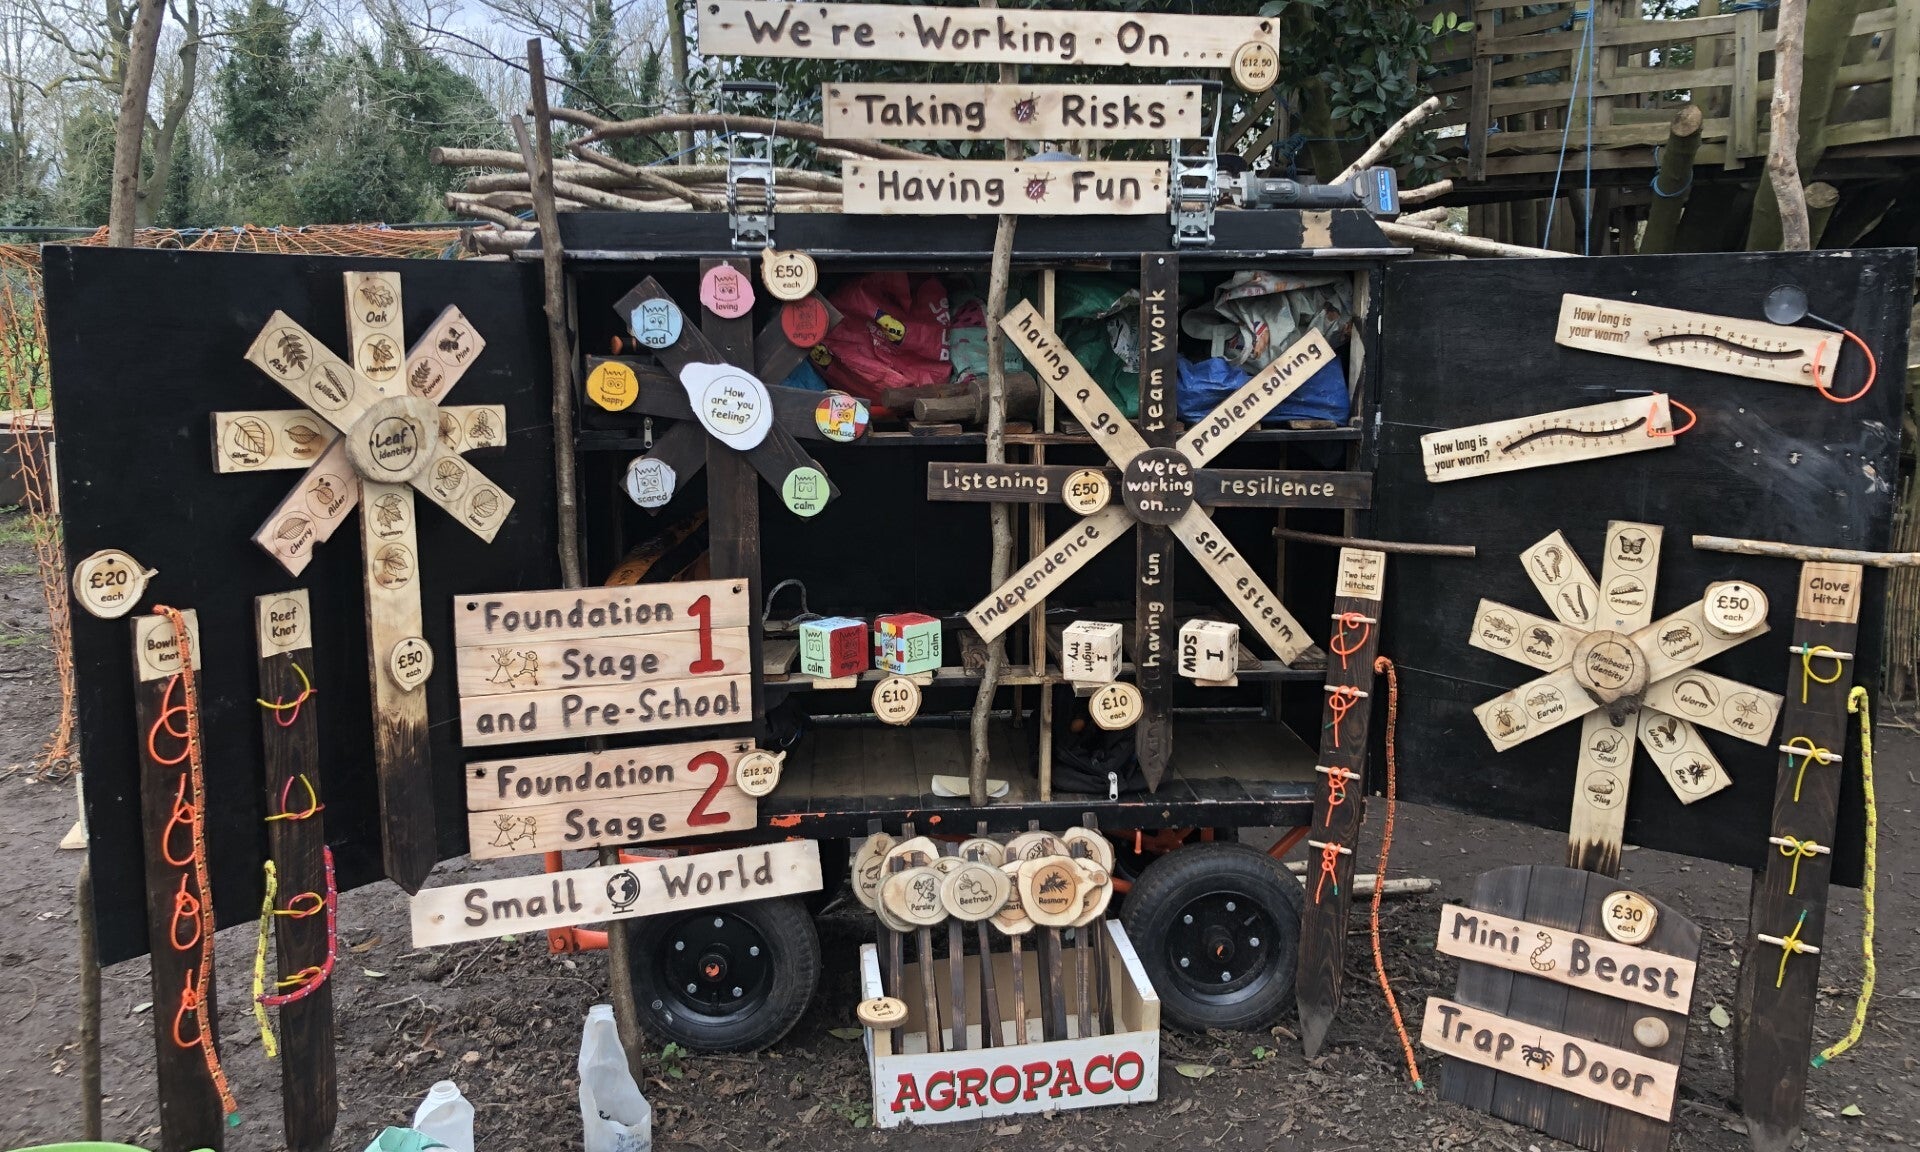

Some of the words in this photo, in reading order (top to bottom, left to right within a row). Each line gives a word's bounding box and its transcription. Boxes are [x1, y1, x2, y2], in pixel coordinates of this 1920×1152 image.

[745, 9, 876, 49] We're
[913, 13, 1079, 58] Working
[1242, 58, 1272, 67] £12.50
[1249, 70, 1265, 78] each
[856, 94, 986, 133] Taking
[1061, 93, 1167, 127] Risks
[878, 170, 1006, 206] Having
[1072, 170, 1141, 202] Fun
[774, 265, 803, 278] £50
[715, 302, 738, 312] loving
[366, 310, 387, 323] Oak
[1573, 307, 1596, 321] How
[1598, 309, 1620, 328] long
[1622, 313, 1633, 327] is
[645, 333, 667, 345] sad
[792, 332, 817, 341] angry
[1568, 325, 1598, 339] your
[1599, 327, 1631, 344] worm?
[455, 346, 470, 363] Pine
[268, 357, 288, 375] Ash
[1017, 312, 1071, 382] having
[1076, 388, 1091, 404] a
[1090, 411, 1119, 437] go
[314, 381, 342, 404] Willow
[422, 374, 443, 397] Rowan
[723, 386, 745, 398] How
[600, 394, 625, 407] happy
[711, 397, 728, 406] are
[736, 400, 755, 413] you
[1146, 367, 1166, 432] team
[1191, 390, 1261, 457] problem
[1262, 341, 1323, 397] solving
[711, 408, 751, 425] feeling?
[375, 430, 409, 450] Leaf
[822, 427, 857, 438] confused
[379, 446, 413, 460] identity
[1433, 441, 1454, 455] How
[1455, 437, 1477, 453] long
[1478, 435, 1489, 447] is
[1434, 456, 1456, 473] your
[1457, 449, 1491, 467] worm?
[1072, 482, 1099, 497] £50
[1126, 477, 1193, 497] working
[1220, 477, 1336, 498] resilience
[328, 494, 346, 517] Alder
[636, 492, 668, 503] scared
[793, 500, 816, 511] calm
[289, 527, 314, 555] Cherry
[1617, 555, 1644, 564] Butterfly
[974, 522, 1101, 627] independence
[1142, 552, 1161, 586] fun
[1344, 570, 1358, 579] Two
[1361, 573, 1376, 581] Half
[88, 569, 128, 590] £20
[1194, 529, 1235, 567] self
[1235, 573, 1295, 644] esteem
[1344, 581, 1375, 590] Hitches
[1810, 577, 1850, 592] Clove
[100, 591, 125, 603] each
[1610, 596, 1644, 606] Caterpillar
[1716, 595, 1749, 610] £50
[1812, 592, 1845, 605] Hitch
[270, 608, 297, 622] Reef
[1723, 613, 1744, 622] each
[272, 624, 298, 638] Knot
[484, 597, 674, 633] Foundation
[687, 594, 725, 674] 1
[1142, 600, 1165, 668] having
[1482, 629, 1511, 645] Earwig
[147, 636, 191, 650] Bowli
[930, 632, 940, 657] calm
[159, 651, 180, 662] Knot
[398, 650, 423, 669] £50
[1081, 641, 1095, 673] might
[1096, 654, 1108, 662] I
[1206, 649, 1224, 662] I
[1526, 645, 1553, 660] Beetle
[561, 648, 659, 682] Stage
[807, 662, 824, 674] calm
[840, 660, 860, 670] angry
[876, 659, 901, 672] confused
[1590, 651, 1631, 672] Minibeast
[405, 668, 422, 678] each
[1590, 662, 1625, 682] identity
[881, 689, 909, 703] £10
[1101, 695, 1128, 710] £10
[1680, 693, 1709, 710] Worm
[476, 702, 538, 735] and
[561, 680, 741, 729] Pre-School
[888, 705, 906, 713] each
[1109, 711, 1127, 720] each
[1536, 703, 1564, 720] Earwig
[1732, 716, 1755, 731] Ant
[1647, 728, 1664, 750] Wasp
[1597, 752, 1617, 764] Snail
[743, 766, 773, 777] £12.50
[1674, 768, 1689, 786] Bee
[497, 759, 675, 799] Foundation
[686, 751, 732, 828] 2
[1593, 792, 1611, 806] Slug
[563, 808, 667, 843] Stage
[464, 878, 583, 928] Small
[658, 851, 775, 900] World
[911, 903, 936, 912] Parsley
[959, 894, 993, 906] Beetroot
[1612, 904, 1643, 922] £30
[1617, 923, 1636, 934] each
[1452, 912, 1520, 954] Mini
[1567, 938, 1680, 999] Beast
[1437, 1004, 1515, 1061] Trap
[1561, 1042, 1655, 1097] Door
[890, 1050, 1145, 1114] AGROPACO
